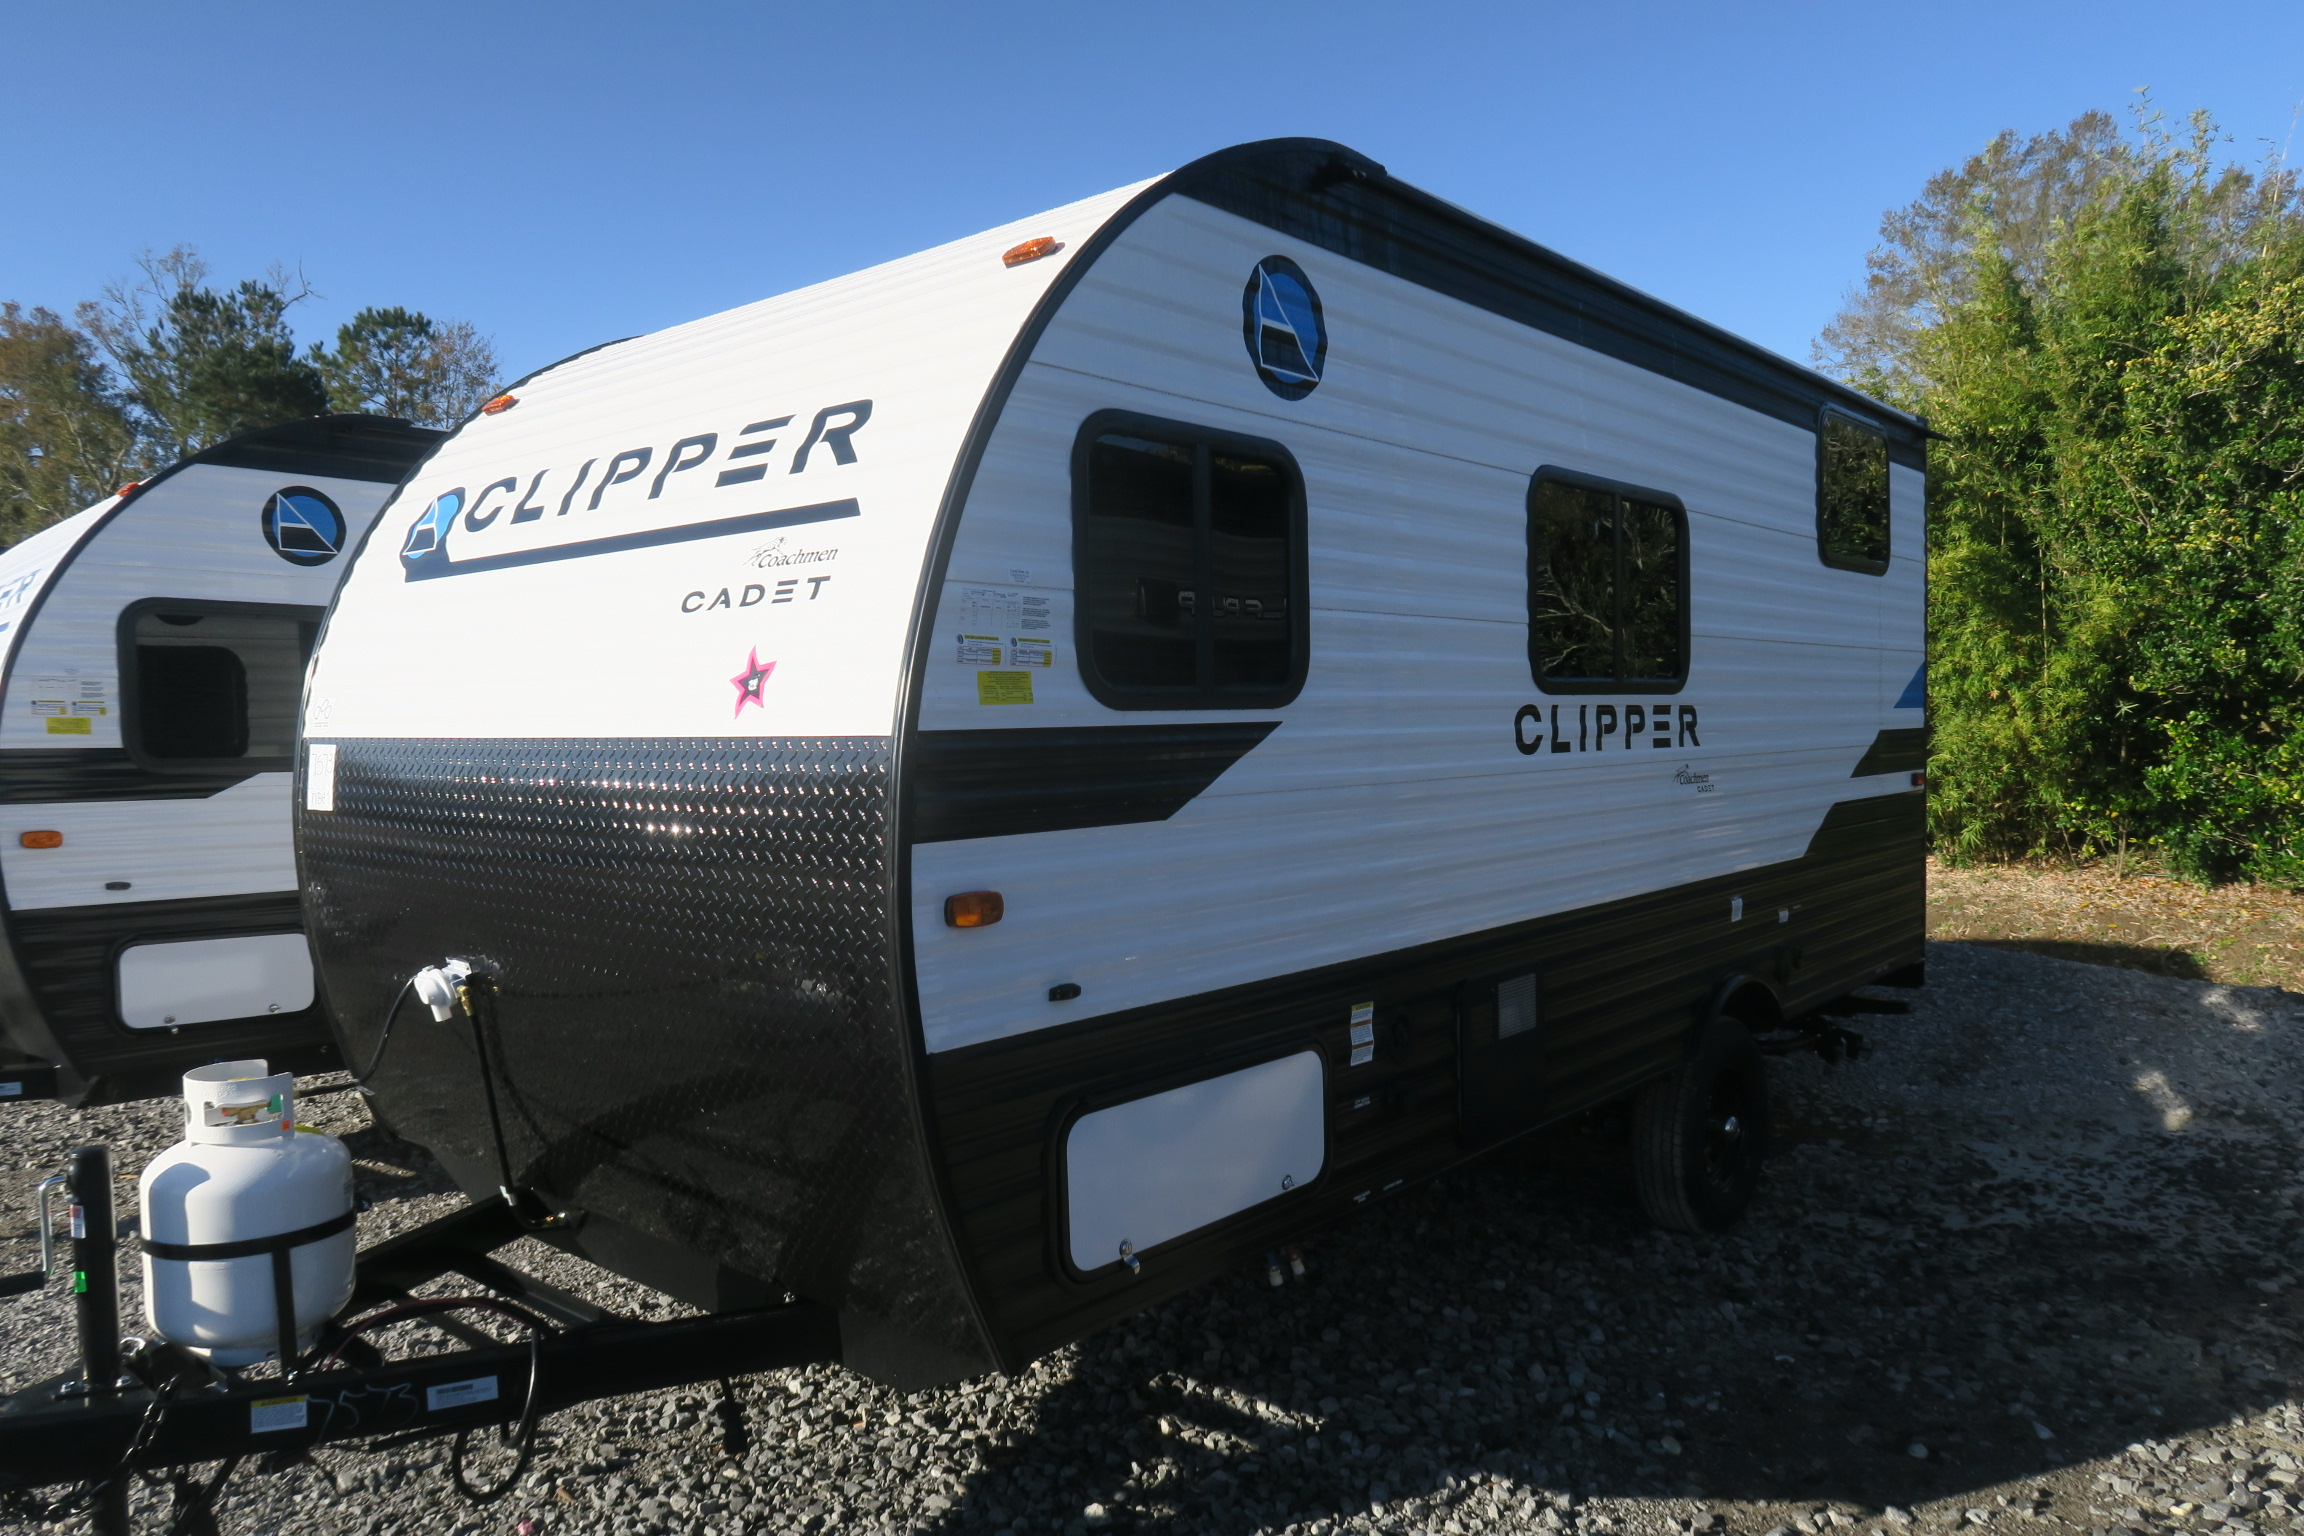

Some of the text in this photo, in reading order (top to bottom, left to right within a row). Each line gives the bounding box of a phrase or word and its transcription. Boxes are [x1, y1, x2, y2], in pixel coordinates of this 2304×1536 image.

[464, 399, 873, 532] CLIPPER
[757, 548, 839, 568] Coachmen
[681, 575, 831, 613] CADET
[1514, 704, 1700, 755] CLIPPER
[1680, 772, 1709, 785] Coachmen
[1696, 784, 1714, 792] CADET
[306, 1383, 419, 1442] 7573
